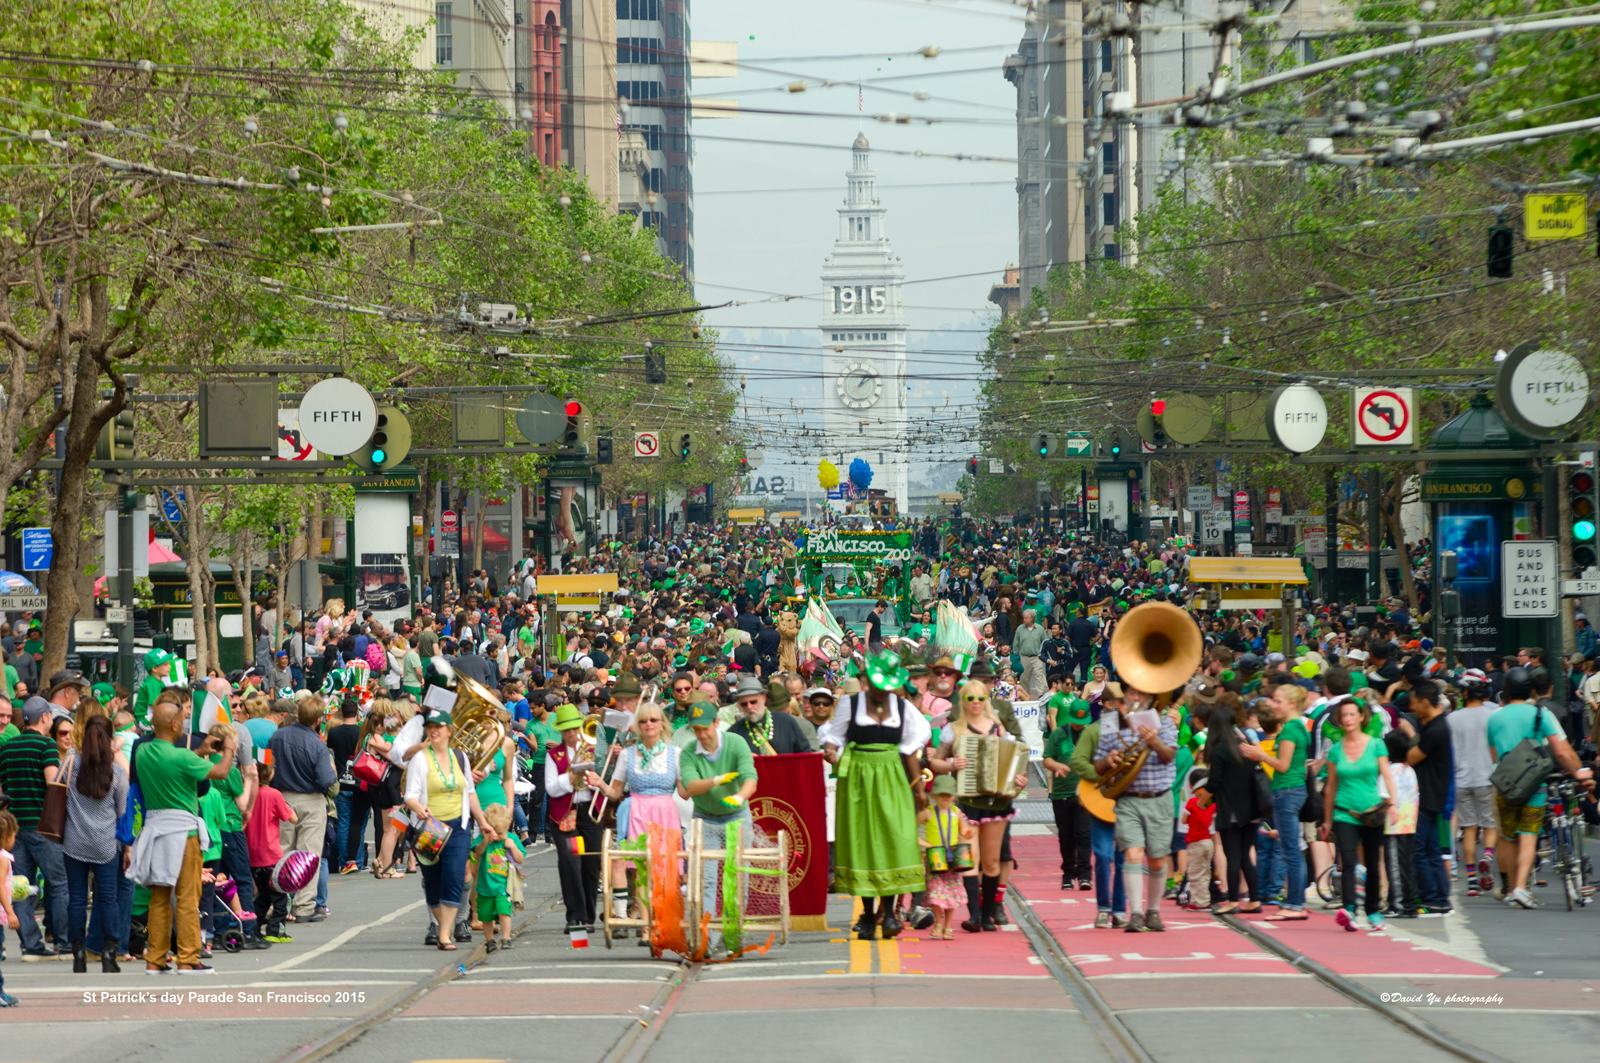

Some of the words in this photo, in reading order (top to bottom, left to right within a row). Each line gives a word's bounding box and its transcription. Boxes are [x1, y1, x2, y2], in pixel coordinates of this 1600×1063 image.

[1542, 203, 1571, 214] MI
[1537, 218, 1573, 230] SIGNAL
[831, 285, 886, 313] 1915
[1526, 381, 1575, 394] FIFTH
[313, 410, 361, 423] FIFTH
[1285, 412, 1318, 424] FIFTH
[1439, 483, 1493, 493] FRANCISCO
[808, 528, 838, 541] SAN
[1206, 528, 1219, 539] 10
[807, 540, 885, 553] FRANCISCO
[885, 548, 911, 561] ZOO
[1517, 549, 1542, 558] BUS
[1517, 562, 1544, 571] AND
[1516, 575, 1546, 583] TAXI
[1513, 587, 1548, 596] LANE
[1577, 582, 1597, 591] 5TH
[22, 598, 46, 608] MAGN
[1513, 600, 1548, 609] ENDS
[1454, 616, 1477, 625] uture
[1479, 614, 1489, 624] of
[1466, 626, 1473, 635] is
[1014, 707, 1037, 718] High
